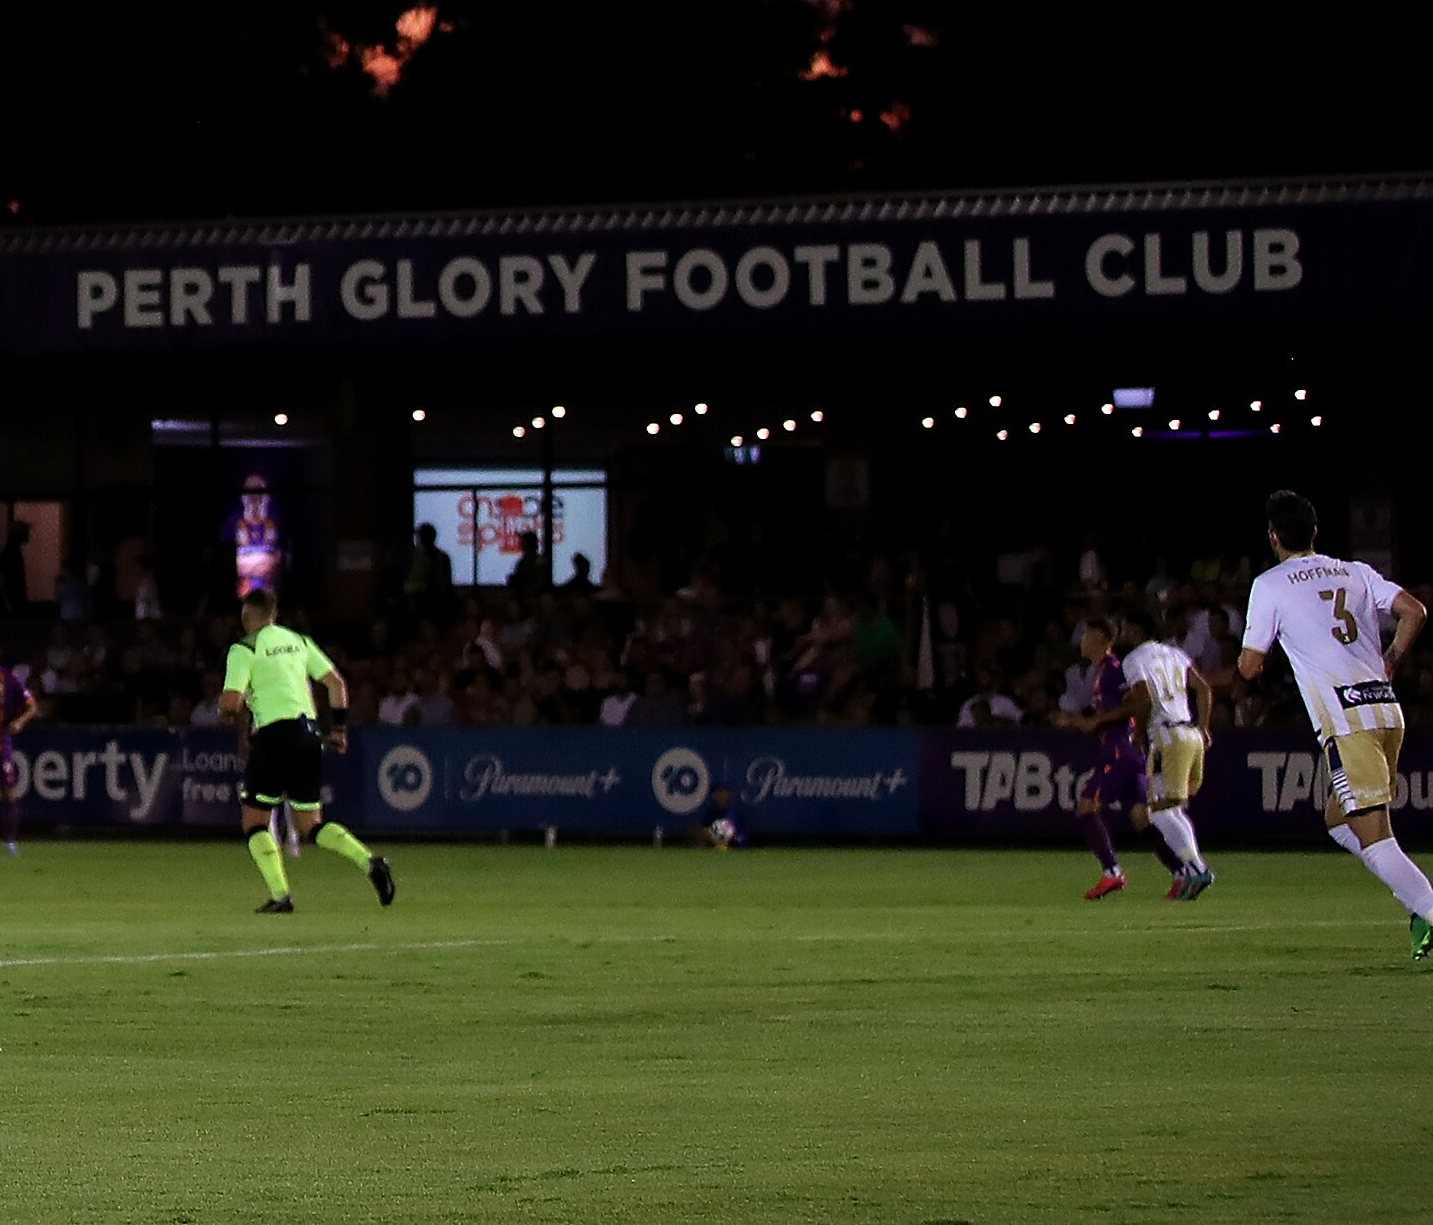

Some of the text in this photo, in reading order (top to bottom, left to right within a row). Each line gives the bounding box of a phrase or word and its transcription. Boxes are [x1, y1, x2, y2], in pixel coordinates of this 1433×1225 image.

[76, 228, 1304, 330] PERTH GLORY FOOTBALL CLUB
[1318, 586, 1358, 645] 3
